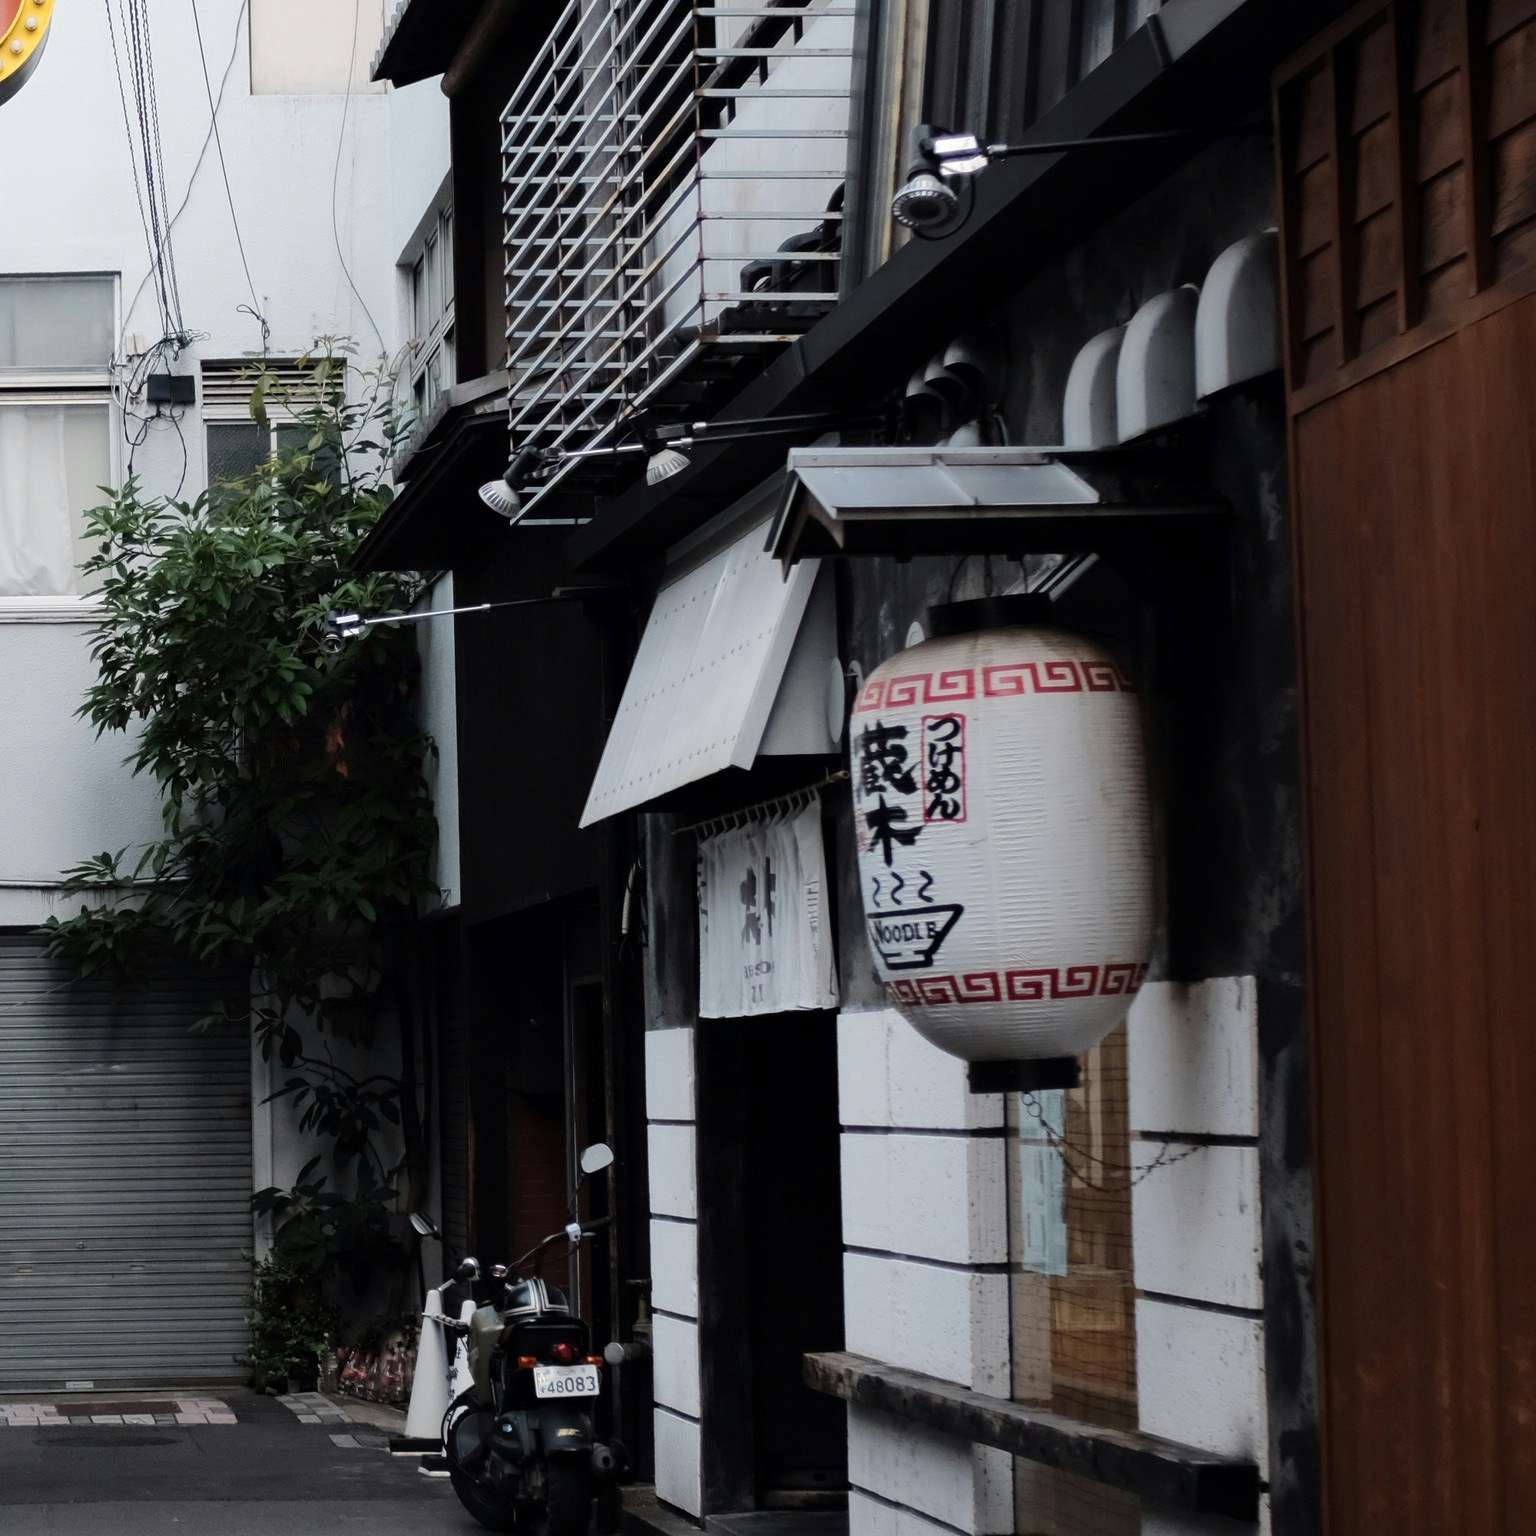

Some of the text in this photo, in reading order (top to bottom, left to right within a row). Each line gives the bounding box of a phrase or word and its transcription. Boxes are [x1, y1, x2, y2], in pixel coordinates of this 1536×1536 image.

[926, 716, 963, 820] つけめん
[873, 919, 940, 945] NOODLE
[547, 1375, 596, 1394] 48083
